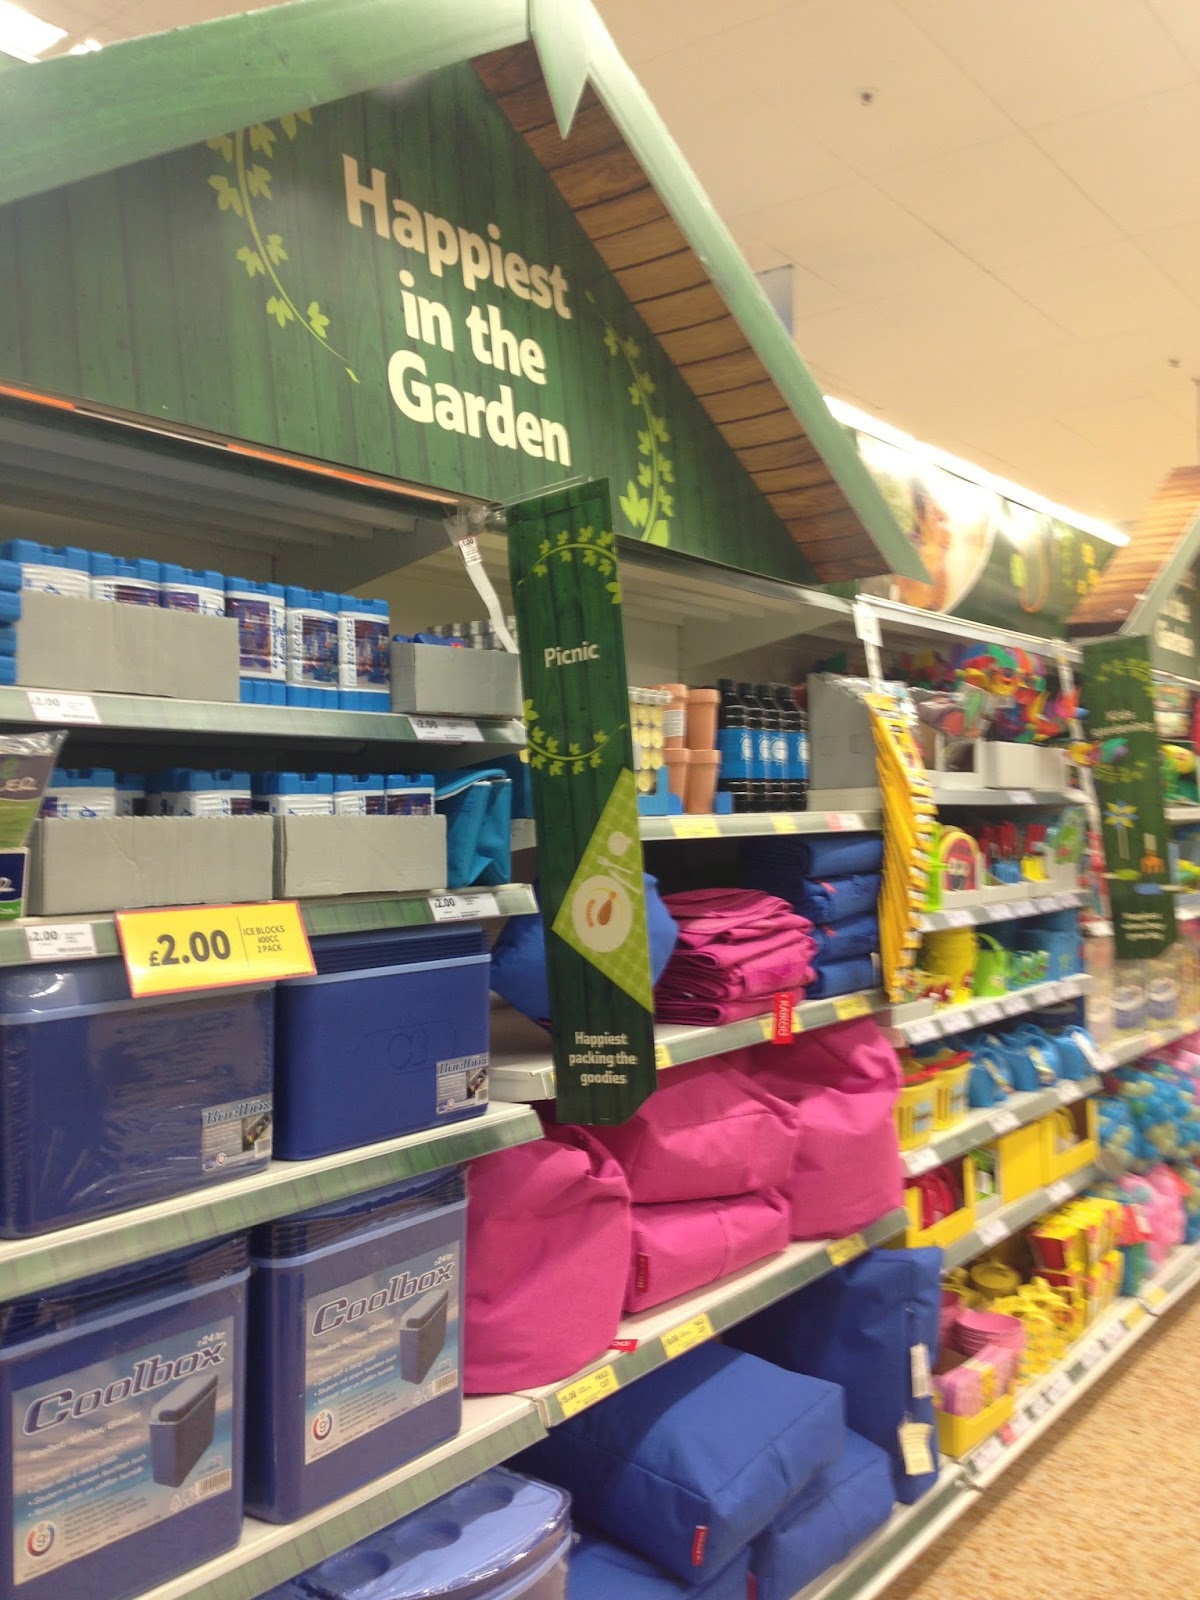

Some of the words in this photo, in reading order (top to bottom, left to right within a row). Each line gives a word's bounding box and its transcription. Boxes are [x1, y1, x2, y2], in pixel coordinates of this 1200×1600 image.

[343, 154, 572, 319] Happiest
[399, 269, 455, 352] in
[465, 304, 548, 385] the
[387, 349, 572, 467] Garden
[543, 640, 600, 669] Picnic
[148, 929, 231, 967] £2.00
[243, 927, 255, 936] ICE
[255, 924, 286, 935] BLOCKS
[257, 934, 280, 944] 400CC
[257, 945, 263, 953] 2
[263, 943, 283, 953] PACK
[574, 1031, 629, 1048] Happiest
[568, 1050, 615, 1068] packing
[615, 1050, 639, 1065] the
[580, 1070, 629, 1087] goodies
[312, 1262, 454, 1337] Coolbox
[23, 1341, 227, 1436] Coolbox
